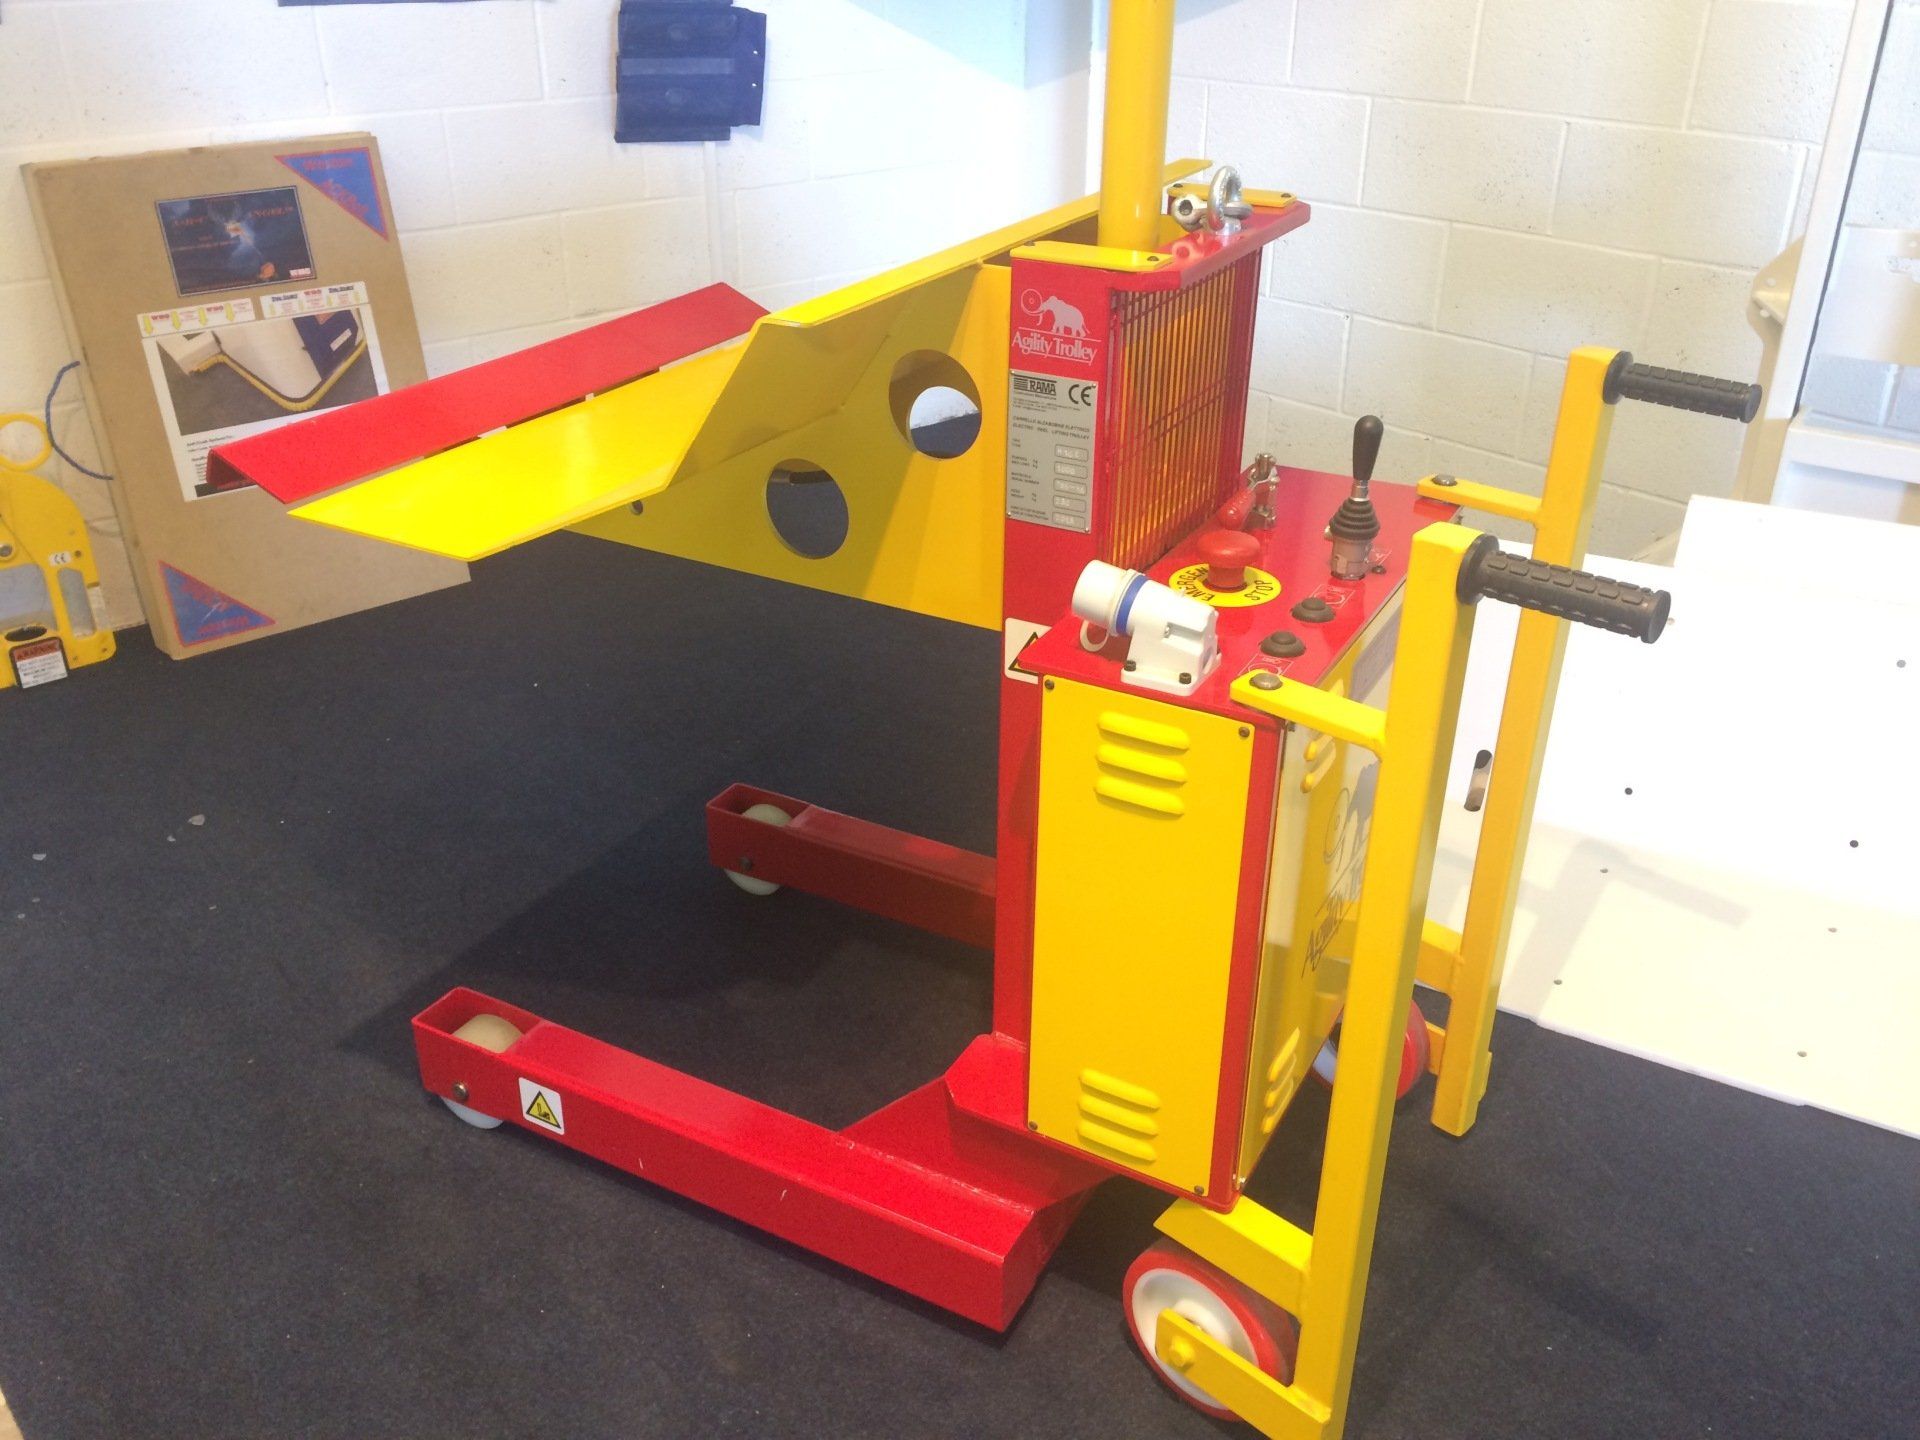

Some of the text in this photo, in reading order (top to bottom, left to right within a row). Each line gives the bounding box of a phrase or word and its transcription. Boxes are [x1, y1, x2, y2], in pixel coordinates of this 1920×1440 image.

[1011, 331, 1098, 366] Agility Trolley
[1029, 379, 1057, 394] RAMA
[1176, 565, 1216, 602] EMERGEN
[1244, 579, 1274, 601] STOP
